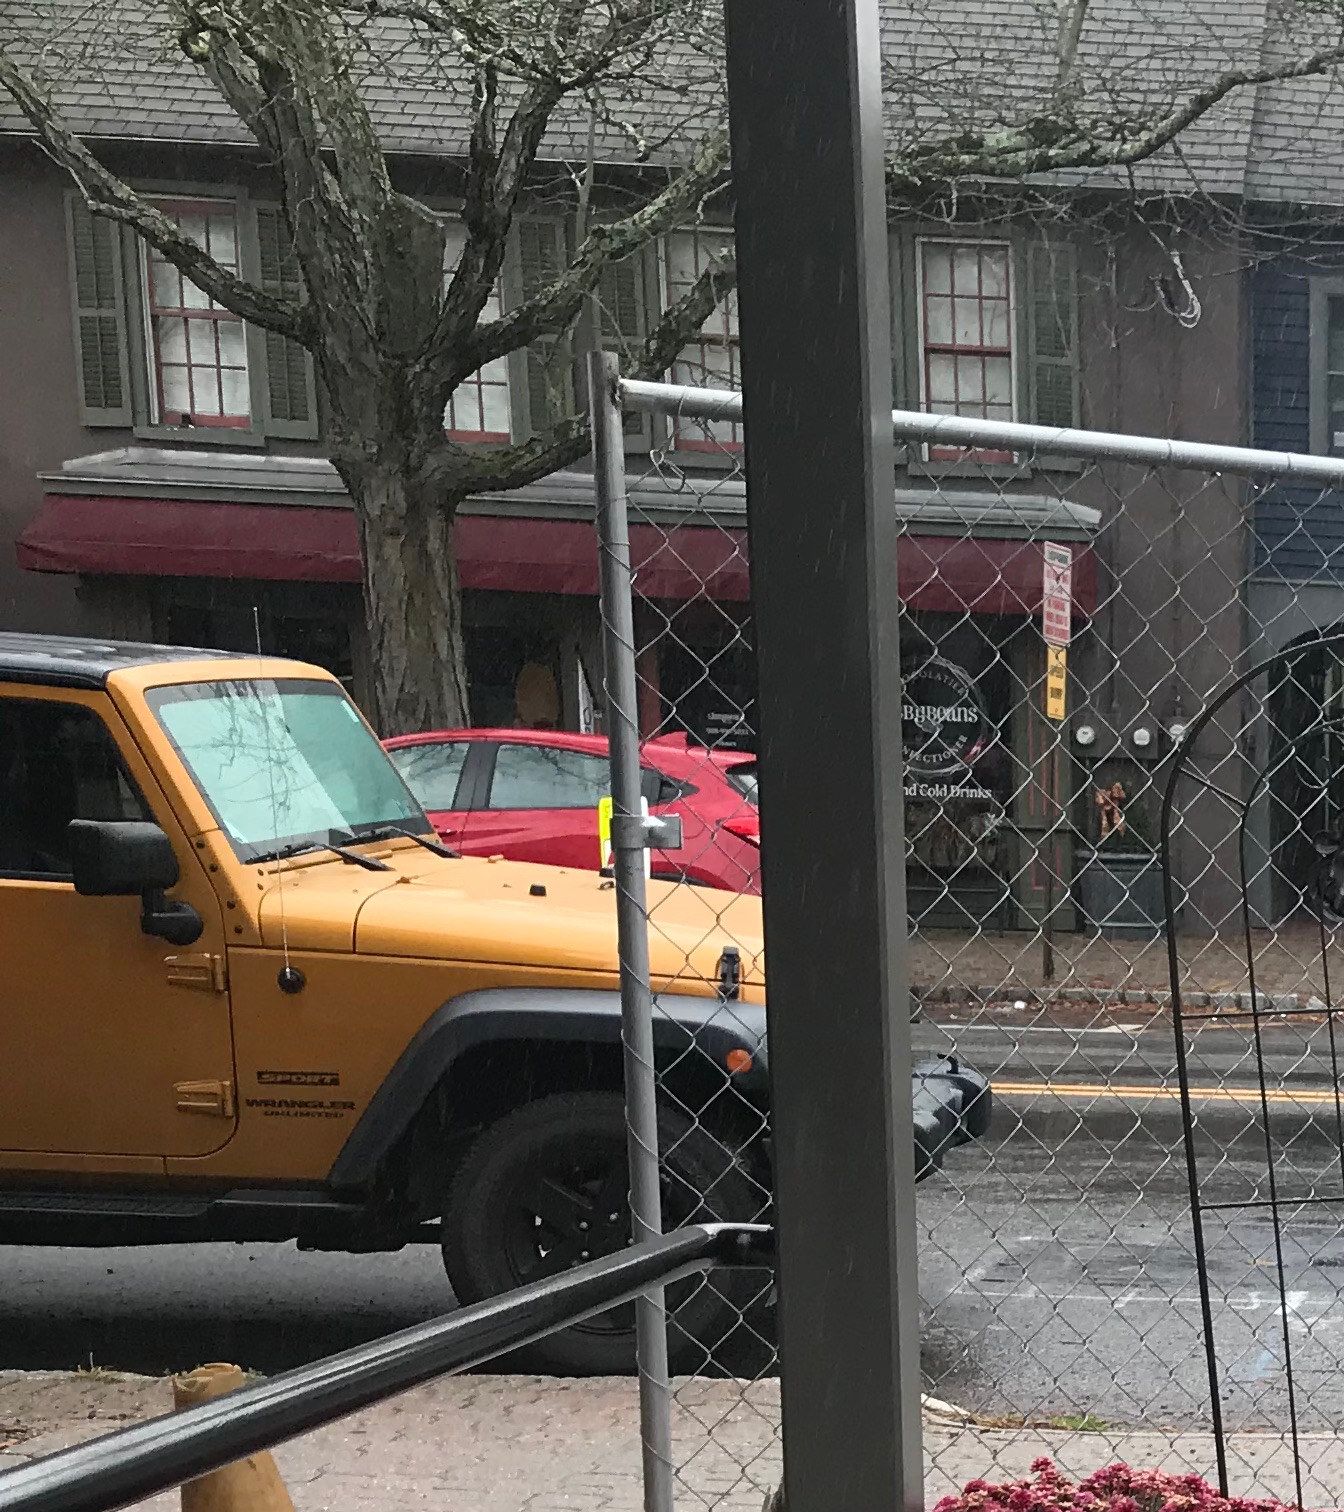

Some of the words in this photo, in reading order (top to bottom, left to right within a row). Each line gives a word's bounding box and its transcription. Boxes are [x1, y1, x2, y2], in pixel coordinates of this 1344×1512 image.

[901, 704, 979, 727] ByBeans
[902, 783, 917, 797] nd
[920, 783, 947, 798] Cold
[949, 785, 992, 799] Drinks
[245, 1098, 356, 1110] WRANGLER
